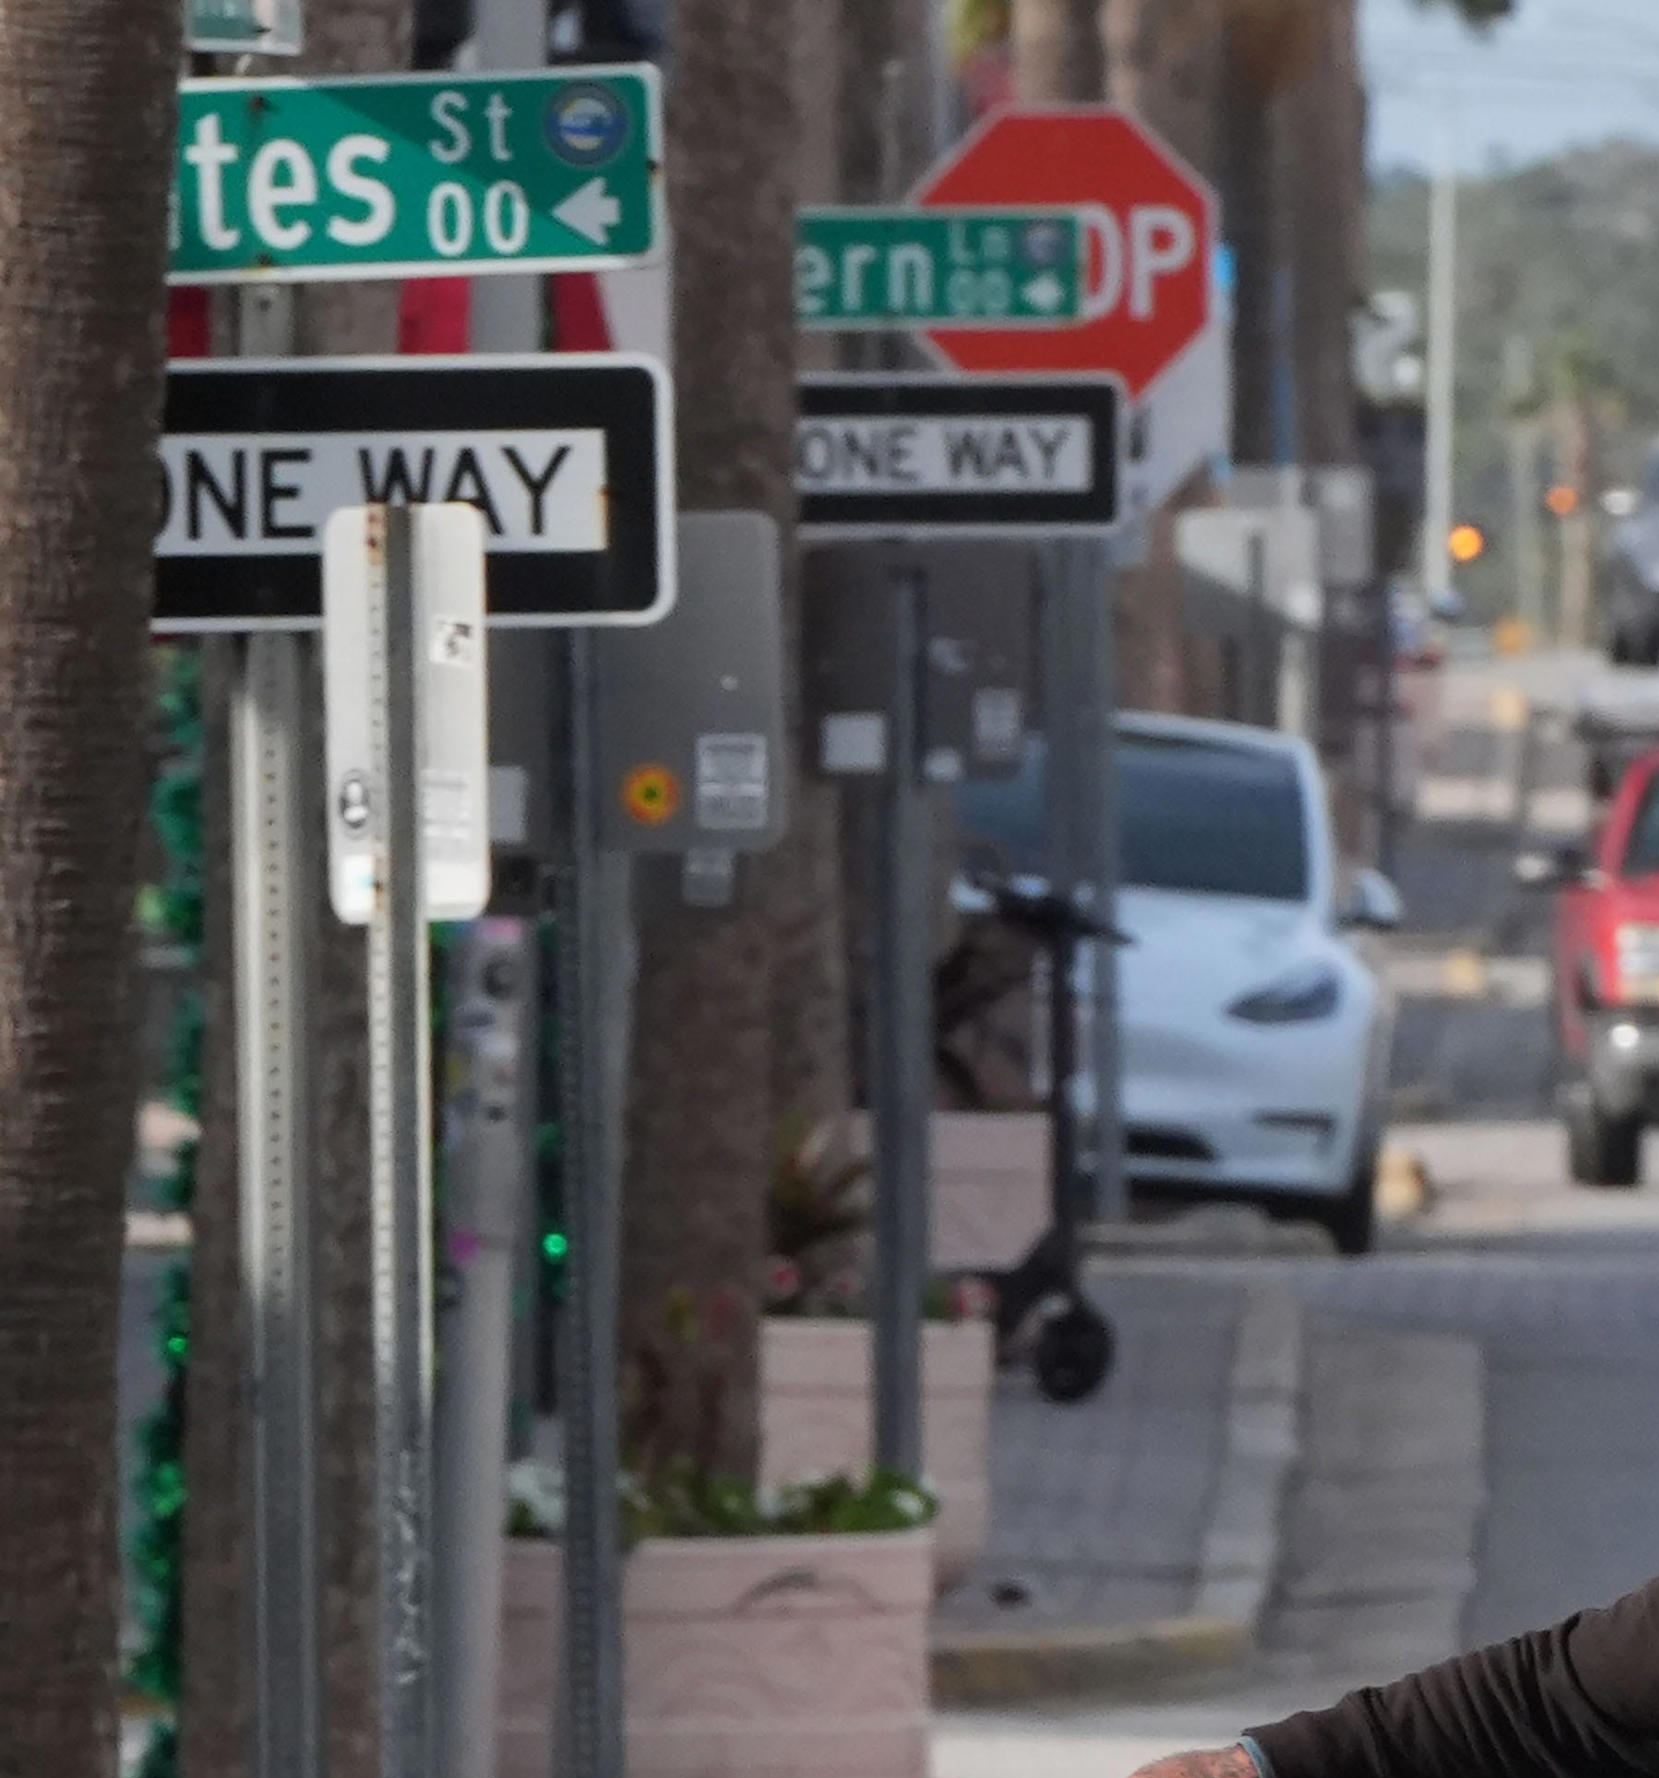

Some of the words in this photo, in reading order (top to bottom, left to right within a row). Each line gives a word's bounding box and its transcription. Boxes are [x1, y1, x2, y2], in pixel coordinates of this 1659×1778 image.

[168, 113, 397, 250] tes
[429, 91, 513, 164] St
[426, 180, 530, 257] 00
[157, 448, 315, 541] NE
[358, 445, 572, 537] WAY
[801, 427, 919, 482] ONE
[947, 427, 1069, 480] WAY
